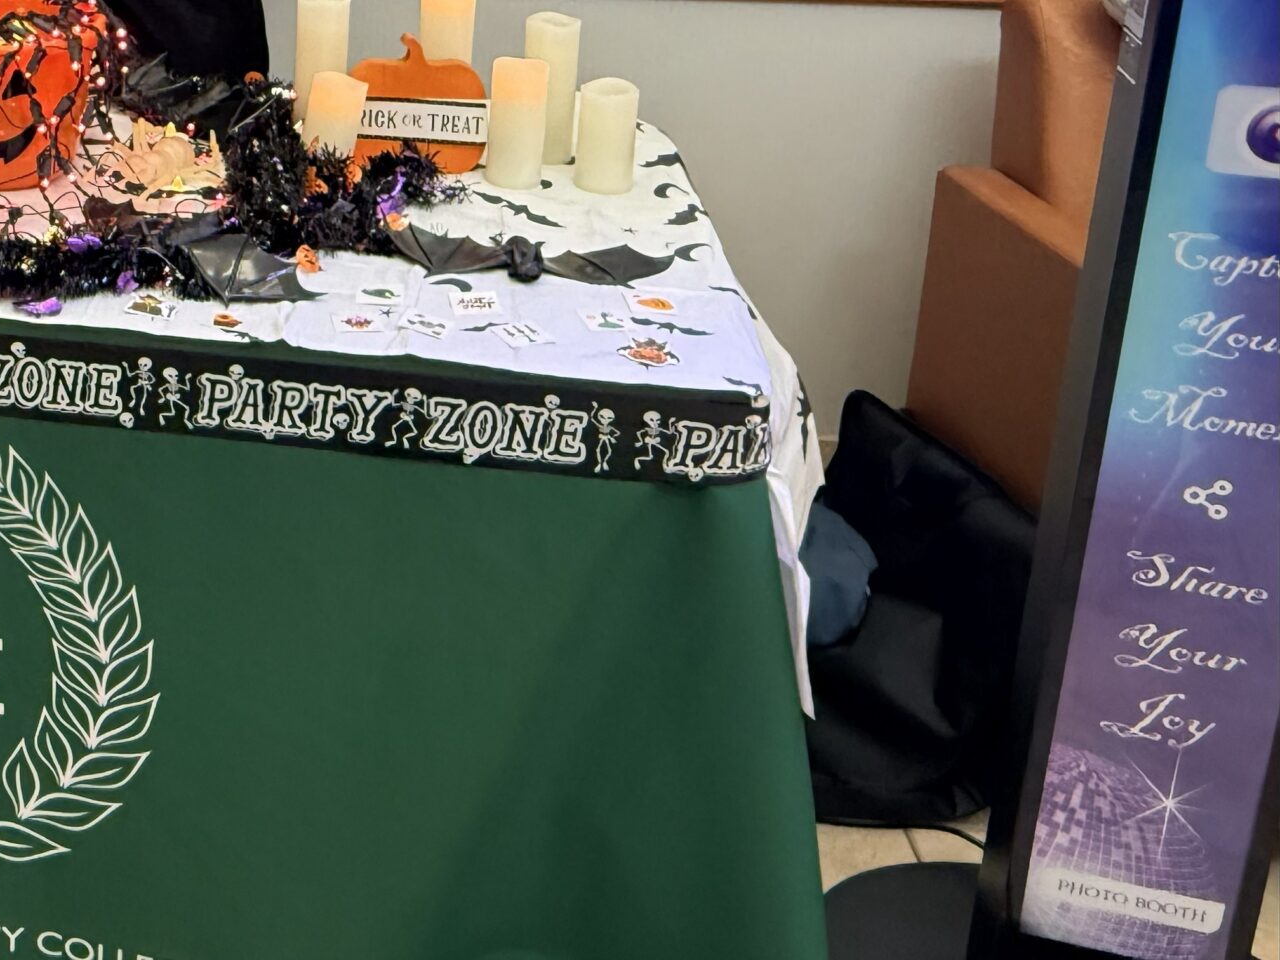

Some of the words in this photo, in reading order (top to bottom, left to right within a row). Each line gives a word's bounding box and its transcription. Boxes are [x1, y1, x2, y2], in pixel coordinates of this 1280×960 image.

[427, 113, 484, 135] TREAT
[1172, 311, 1280, 359] You
[194, 372, 391, 444] PARTY
[421, 395, 588, 464] ZONE
[1128, 385, 1280, 441] Mome
[1126, 550, 1269, 605] Share
[1114, 623, 1248, 674] Your
[1099, 693, 1216, 748] Joy
[1058, 878, 1129, 905] PHOTO
[1135, 897, 1207, 923] BOOTH
